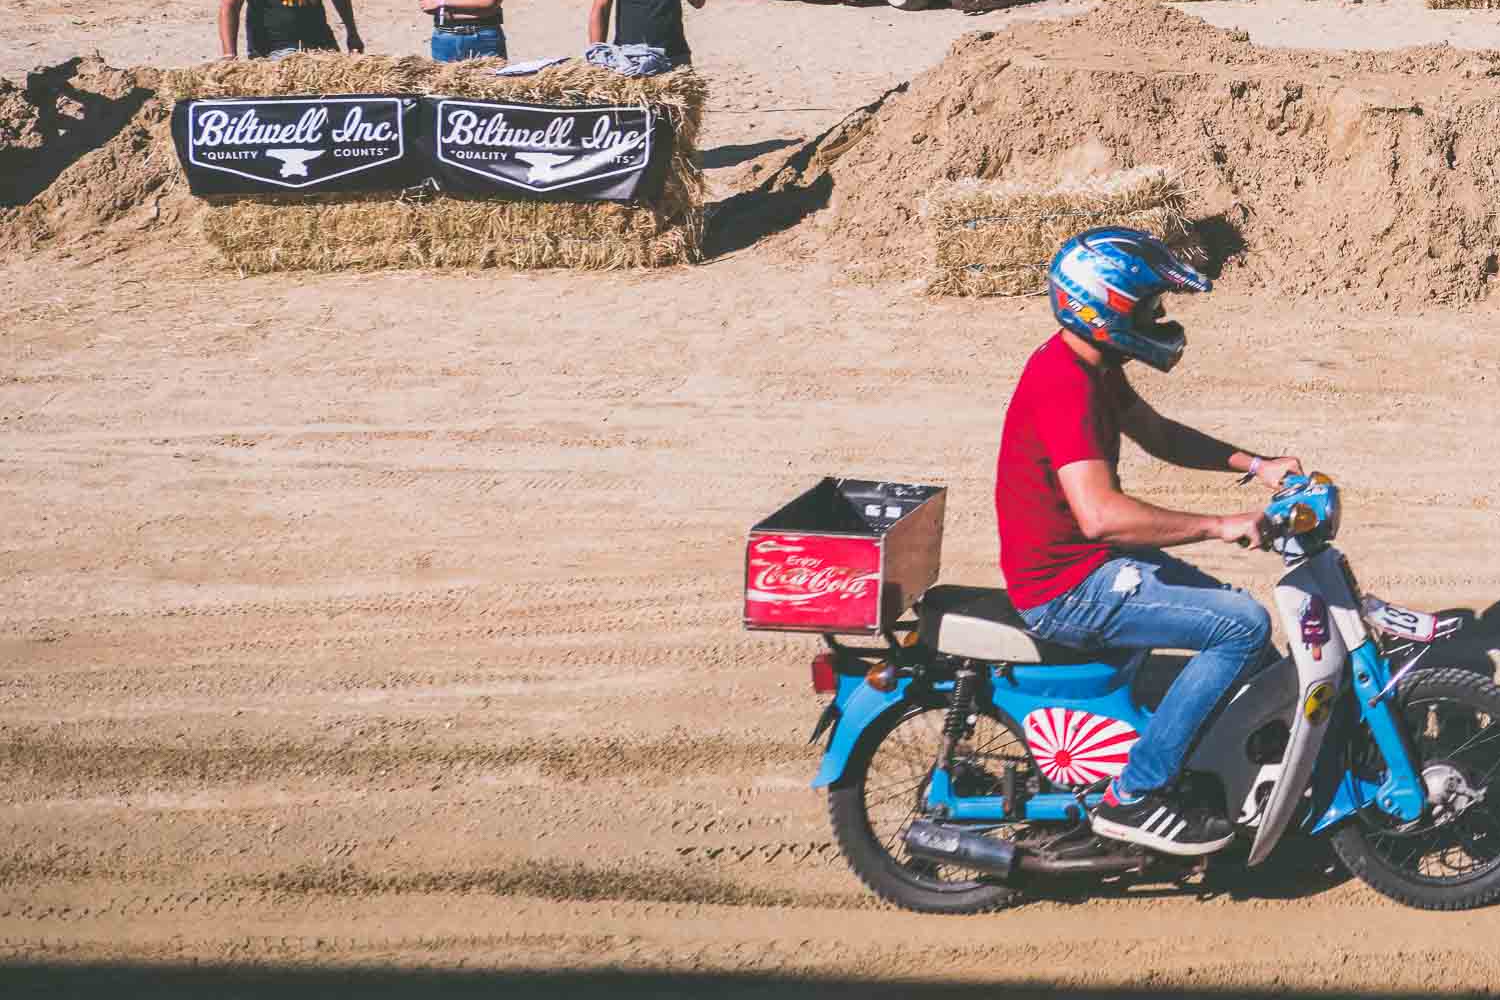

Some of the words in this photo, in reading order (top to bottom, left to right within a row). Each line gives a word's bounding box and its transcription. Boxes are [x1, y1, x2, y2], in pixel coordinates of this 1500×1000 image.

[194, 107, 328, 146] Biltwell
[332, 106, 398, 142] Inc.
[441, 110, 575, 147] Biltwell
[582, 115, 645, 149] Inc.
